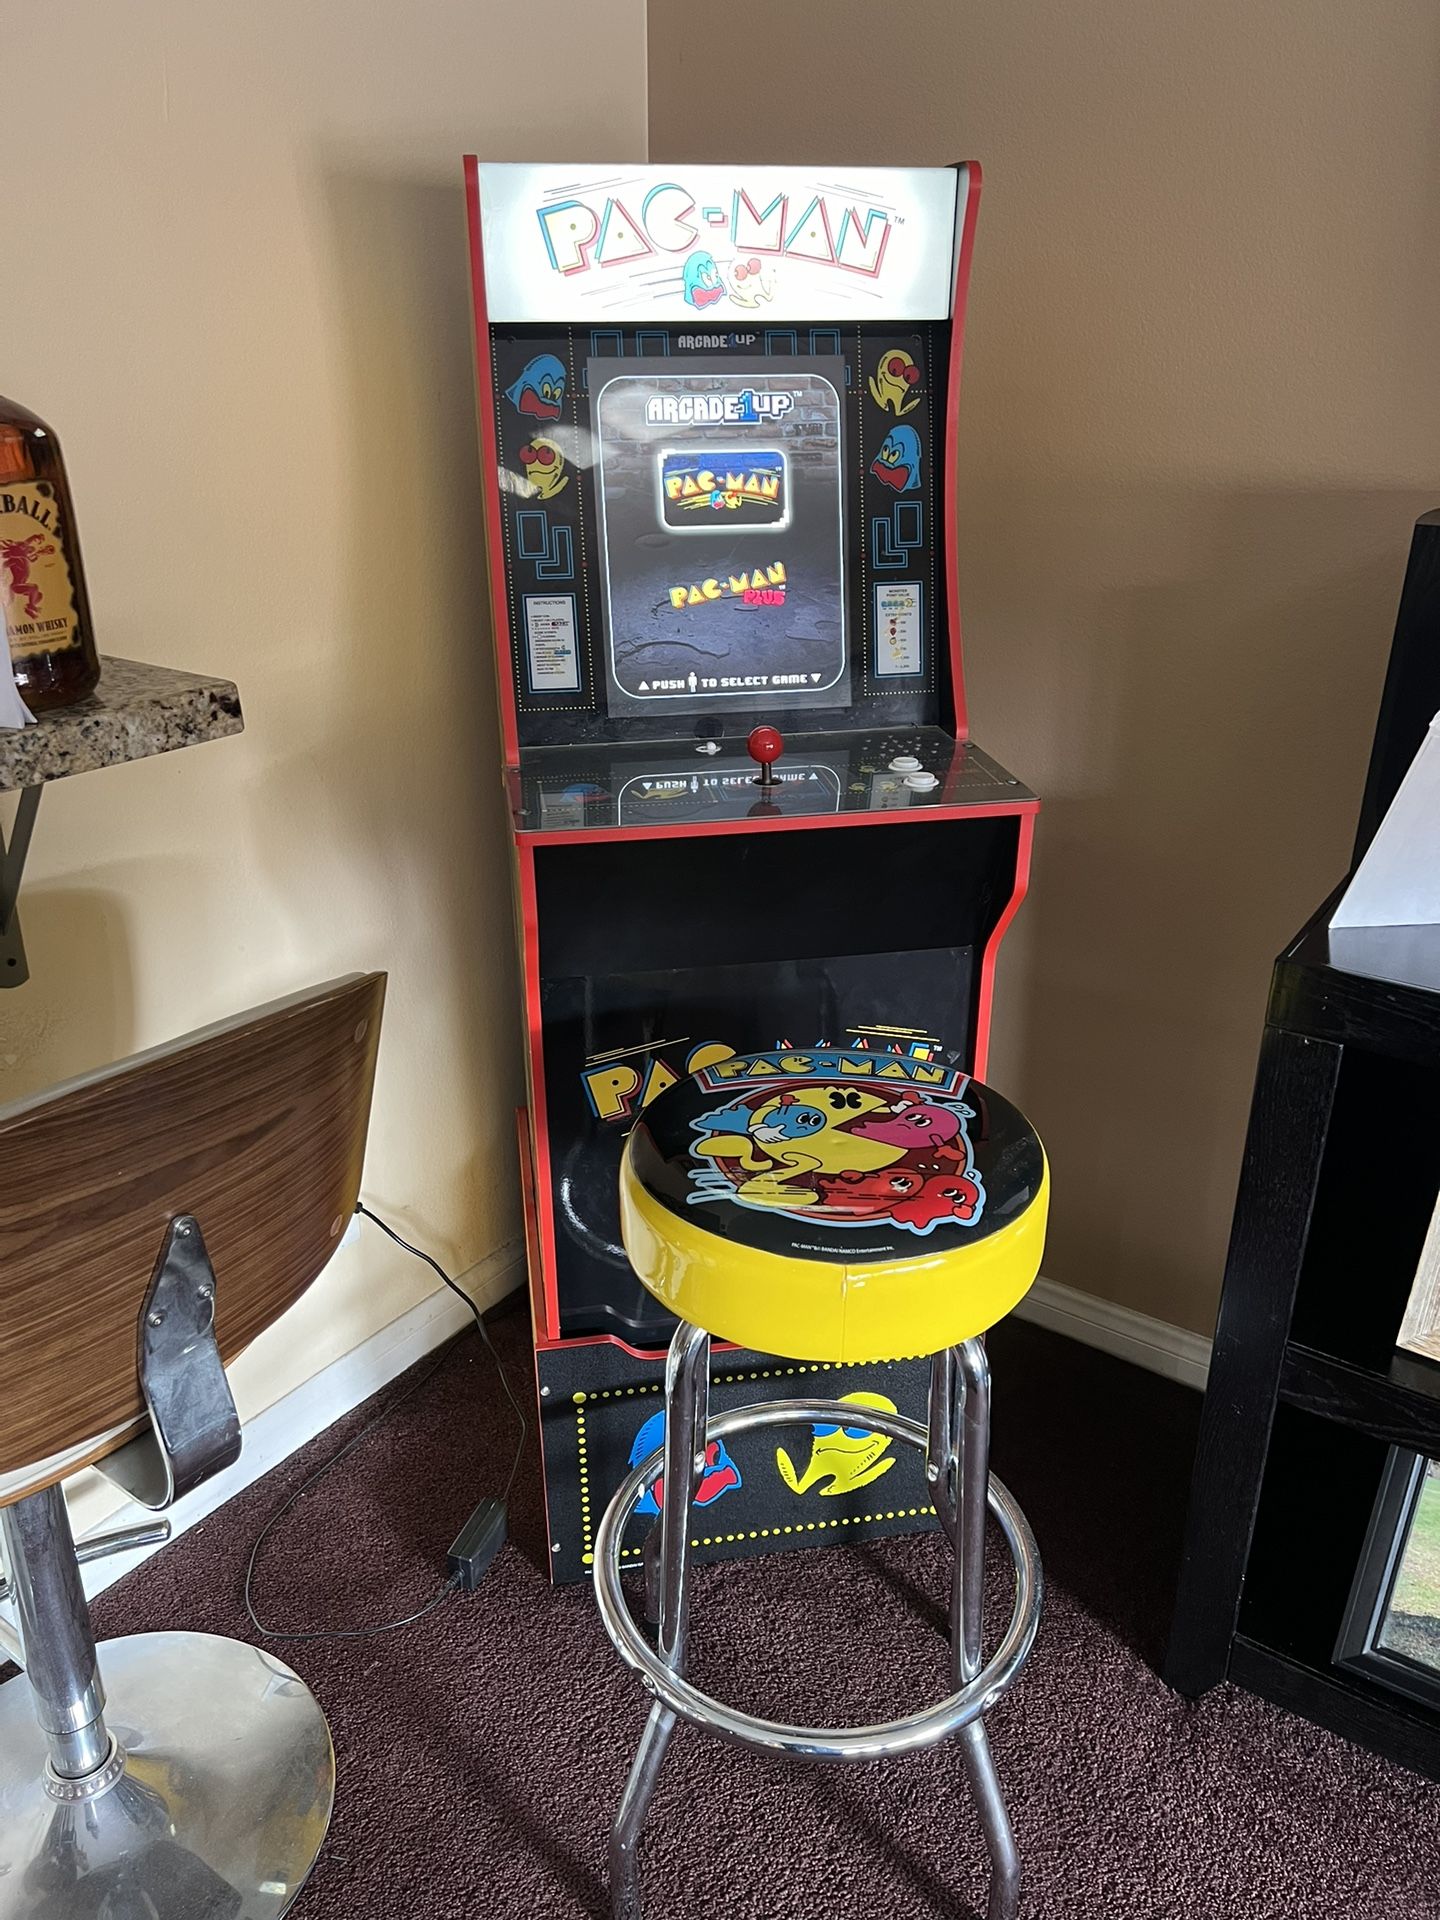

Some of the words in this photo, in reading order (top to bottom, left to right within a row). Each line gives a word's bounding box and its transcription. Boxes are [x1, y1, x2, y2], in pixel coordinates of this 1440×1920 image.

[536, 182, 892, 279] PAC-MAN
[646, 389, 793, 425] ARCADE1UP
[664, 470, 780, 499] PAC-MAN
[0, 494, 51, 528] BALL
[669, 561, 787, 609] PAC-MAN
[742, 589, 786, 606] PLUS
[7, 623, 35, 636] AMON
[36, 617, 67, 632] WHISKY
[652, 680, 685, 690] PUSH
[701, 678, 718, 688] TO
[721, 676, 769, 687] SELECT
[772, 674, 808, 685] GAME
[712, 1056, 944, 1084] PAC-MAN
